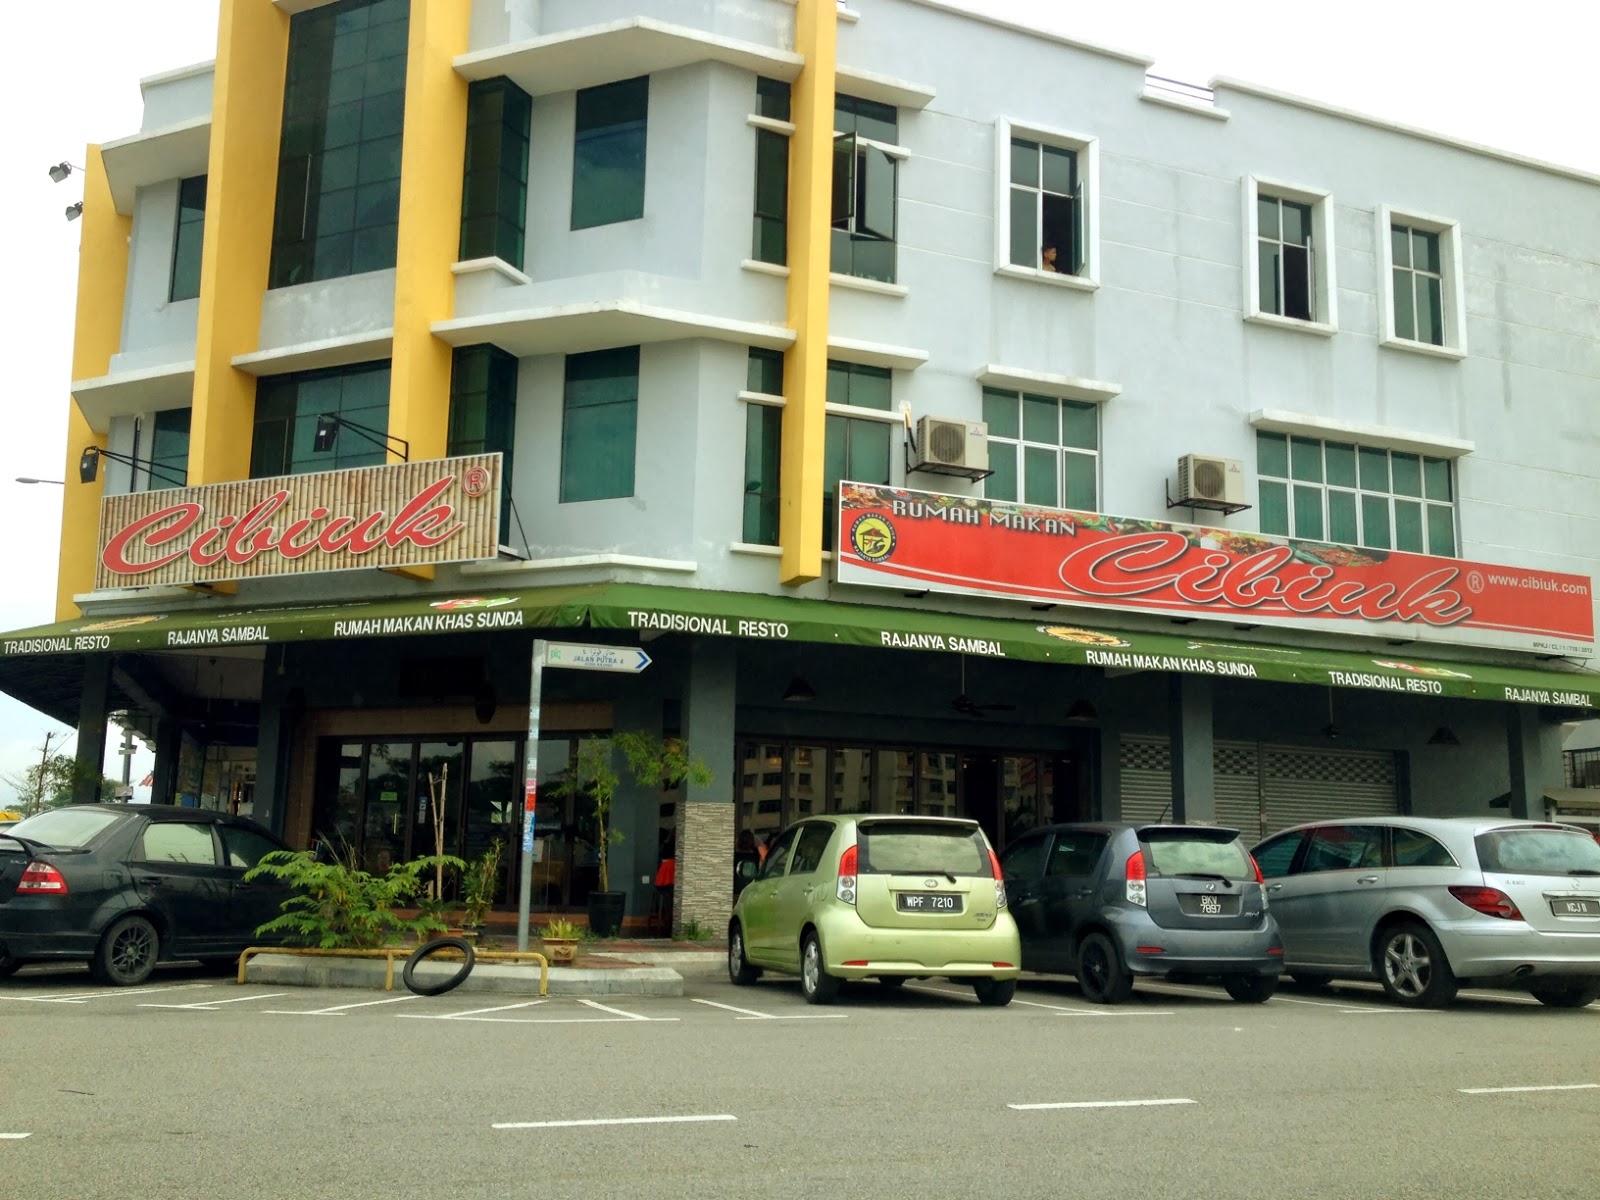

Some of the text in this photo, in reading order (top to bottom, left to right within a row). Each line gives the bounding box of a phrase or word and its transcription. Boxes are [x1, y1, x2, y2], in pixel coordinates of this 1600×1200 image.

[102, 475, 465, 574] Cibiuk
[892, 500, 1077, 536] RUMAH MAKAN
[1058, 532, 1472, 626] Cibiuk
[1488, 574, 1588, 595] www.cibiuk.com
[334, 611, 523, 636] RUMAH MAKAN KHAS SUNDA
[628, 611, 789, 638] TRADISIONAL RESTO
[4, 635, 110, 654] TRADISIONAL RESTO
[168, 626, 269, 645] RAJANYA SAMBAL
[880, 631, 1006, 657] RAJANYA SAMBAL
[573, 655, 595, 663] JALAN
[596, 656, 618, 664] PUTRA
[1086, 650, 1258, 678] RUMAH MAKAN KHAS SUNDA
[1328, 671, 1442, 694] TRADISIONAL RESTO
[1505, 687, 1593, 707] RAJANYA SAMBAL
[906, 896, 954, 909] WPF 7210
[1200, 904, 1222, 914] 7897
[1201, 895, 1218, 905] BKV
